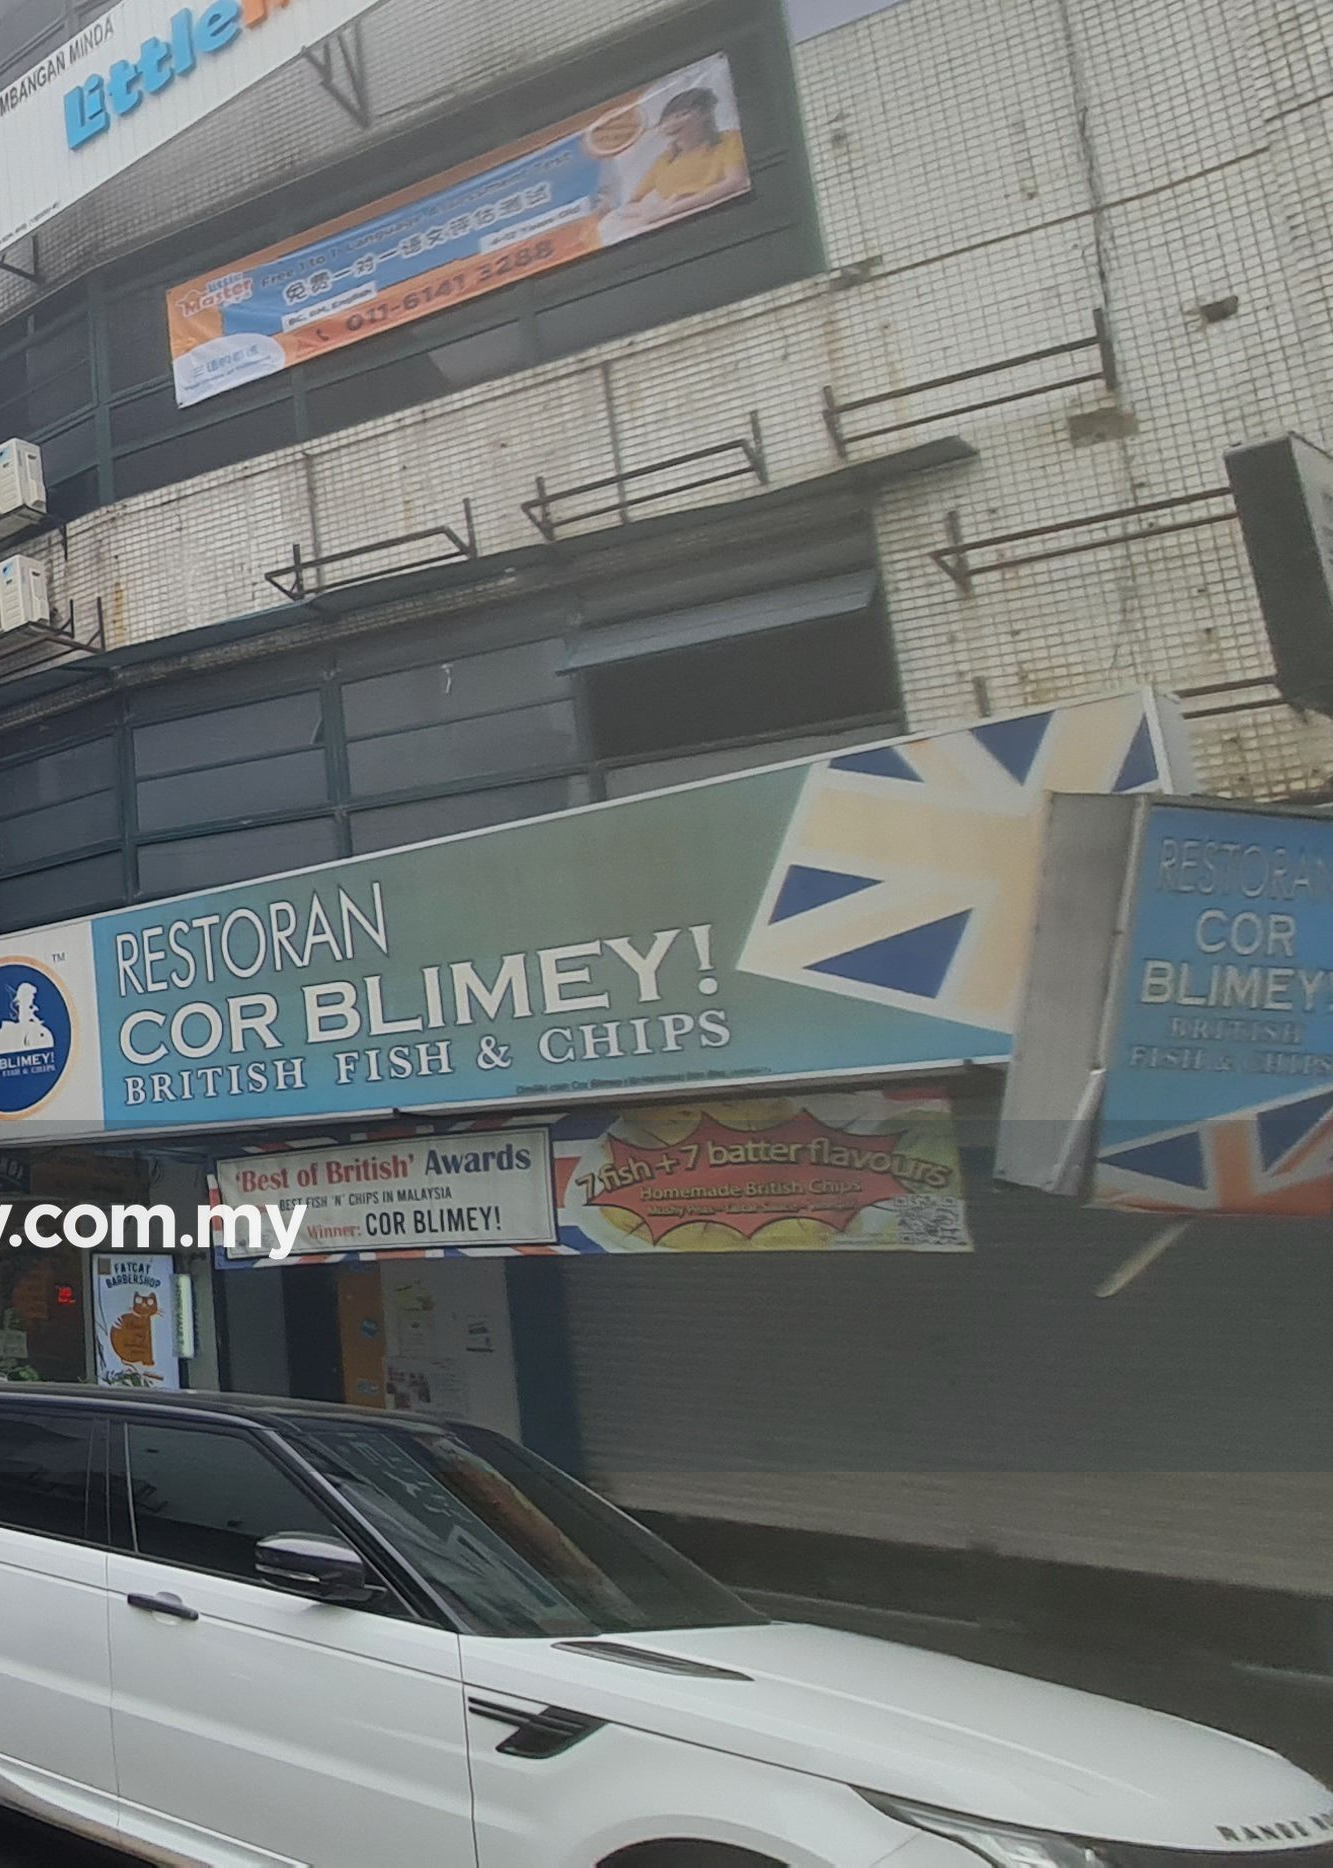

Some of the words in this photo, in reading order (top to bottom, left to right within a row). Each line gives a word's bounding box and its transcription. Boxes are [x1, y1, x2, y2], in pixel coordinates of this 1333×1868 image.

[69, 17, 114, 65] MINDA
[64, 0, 241, 151] Little
[115, 879, 389, 997] RESTORAN
[1195, 909, 1297, 958] COR
[118, 990, 279, 1067] COR
[304, 922, 717, 1045] BLIMEY!
[1170, 1016, 1303, 1045] BRITISH
[124, 1055, 307, 1107] BRITISH
[336, 1040, 455, 1086] FISH
[475, 1034, 513, 1070] &
[537, 1008, 733, 1065] CHIPS
[1129, 1045, 1205, 1070] FISH
[297, 1165, 319, 1188] of
[425, 1144, 531, 1176] Awards
[576, 1174, 598, 1201] 7
[599, 1156, 652, 1192] fish
[680, 1145, 699, 1171] 7
[707, 1138, 804, 1166] batter
[806, 1137, 954, 1187] flavours
[306, 1195, 327, 1208] FISH
[348, 1191, 379, 1205] CHIPS
[383, 1190, 394, 1203] IN
[397, 1187, 452, 1201] MALAYSIA
[640, 1183, 741, 1201] Homemade
[744, 1180, 804, 1197] British
[809, 1178, 862, 1196] Chips
[307, 1224, 361, 1240] Winner:
[365, 1212, 405, 1236] COR
[414, 1206, 501, 1234] BLIMEY!
[114, 1262, 152, 1274] FATCAT
